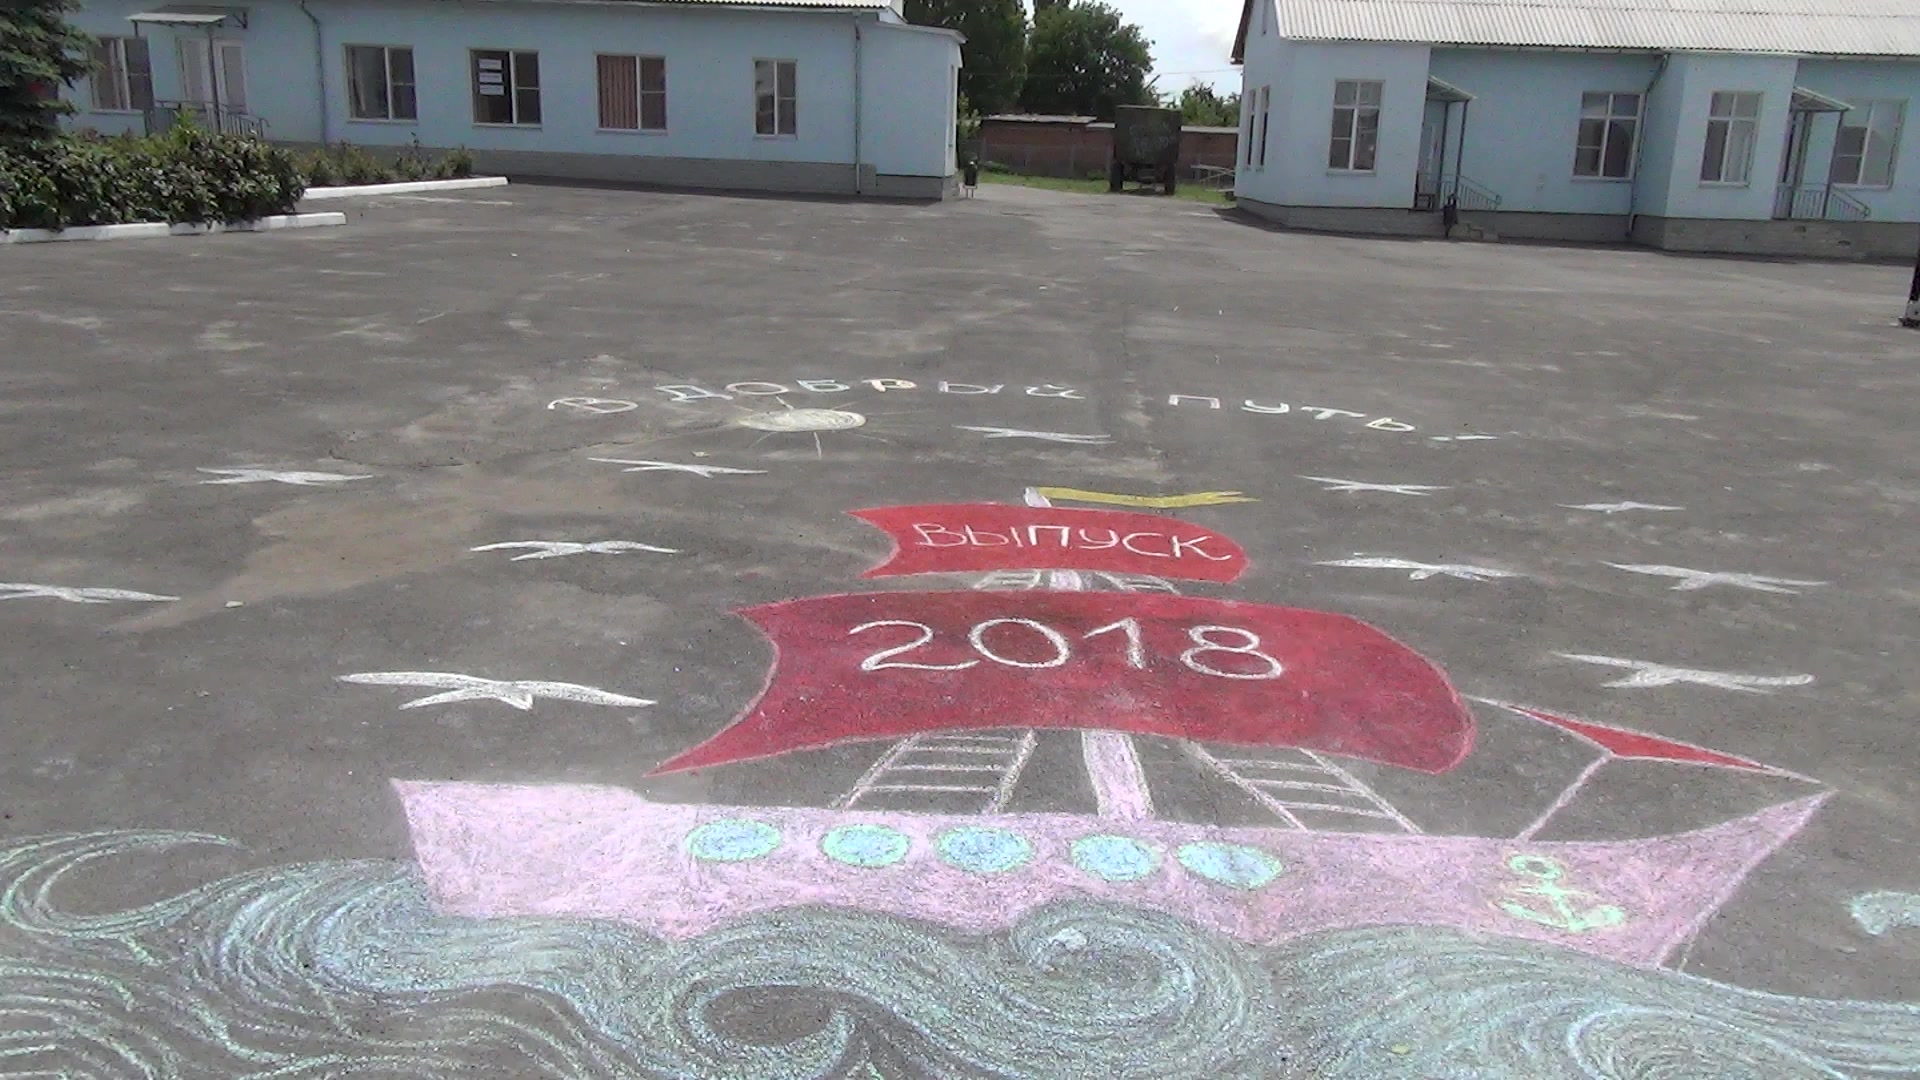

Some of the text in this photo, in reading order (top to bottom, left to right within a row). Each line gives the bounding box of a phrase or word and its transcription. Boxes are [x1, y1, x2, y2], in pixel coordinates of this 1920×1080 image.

[654, 378, 1086, 401] ДОБРЫЙ
[912, 523, 1232, 561] ВЫПУСК
[848, 617, 1284, 680] 2018
